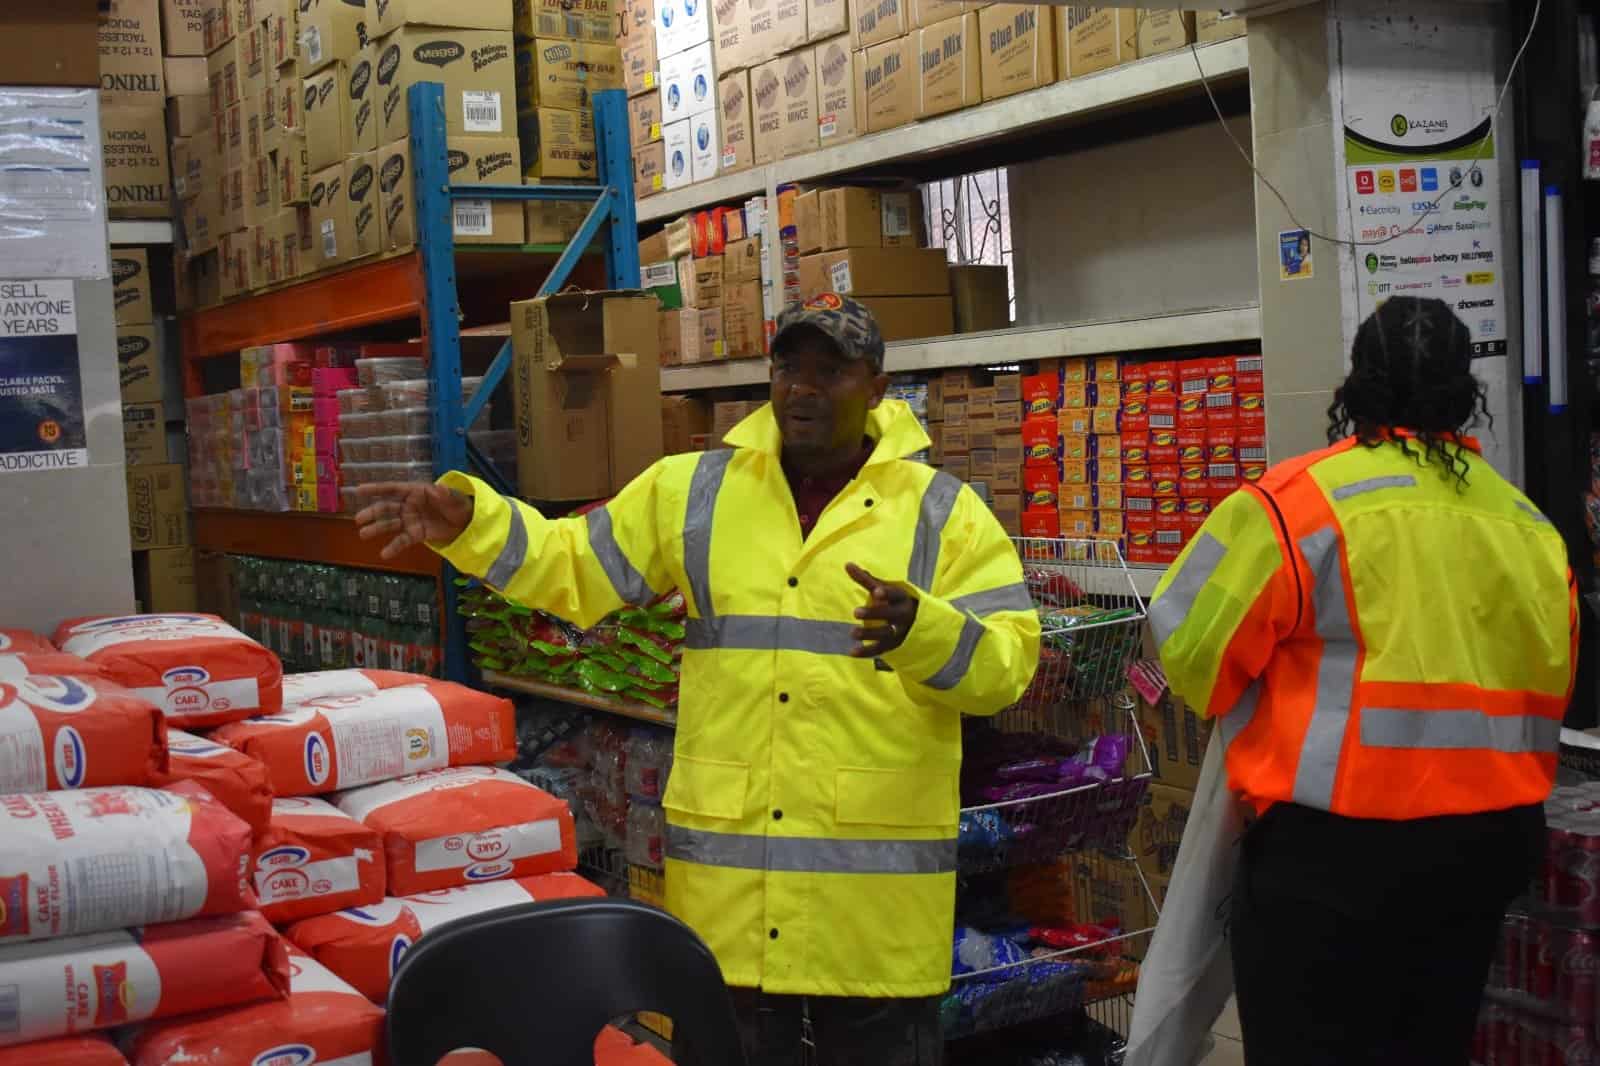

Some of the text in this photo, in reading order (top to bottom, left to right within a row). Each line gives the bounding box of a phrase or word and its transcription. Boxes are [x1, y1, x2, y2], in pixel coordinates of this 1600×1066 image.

[990, 7, 1035, 54] Blue Mix
[922, 34, 962, 74] Blue Mix
[473, 53, 508, 72] Noodles
[100, 74, 160, 92] TRINC
[788, 108, 808, 123] MINCE
[478, 159, 513, 180] Noodles
[1433, 252, 1458, 263] betway
[1, 283, 48, 299] SELL
[4, 300, 72, 316] ANYONE
[3, 318, 59, 334] YEARS
[30, 385, 56, 394] TASTE
[0, 451, 78, 469] ADDICTIVE
[175, 696, 199, 705] CAKE
[477, 841, 502, 853] CAKE
[271, 879, 298, 890] CAKE
